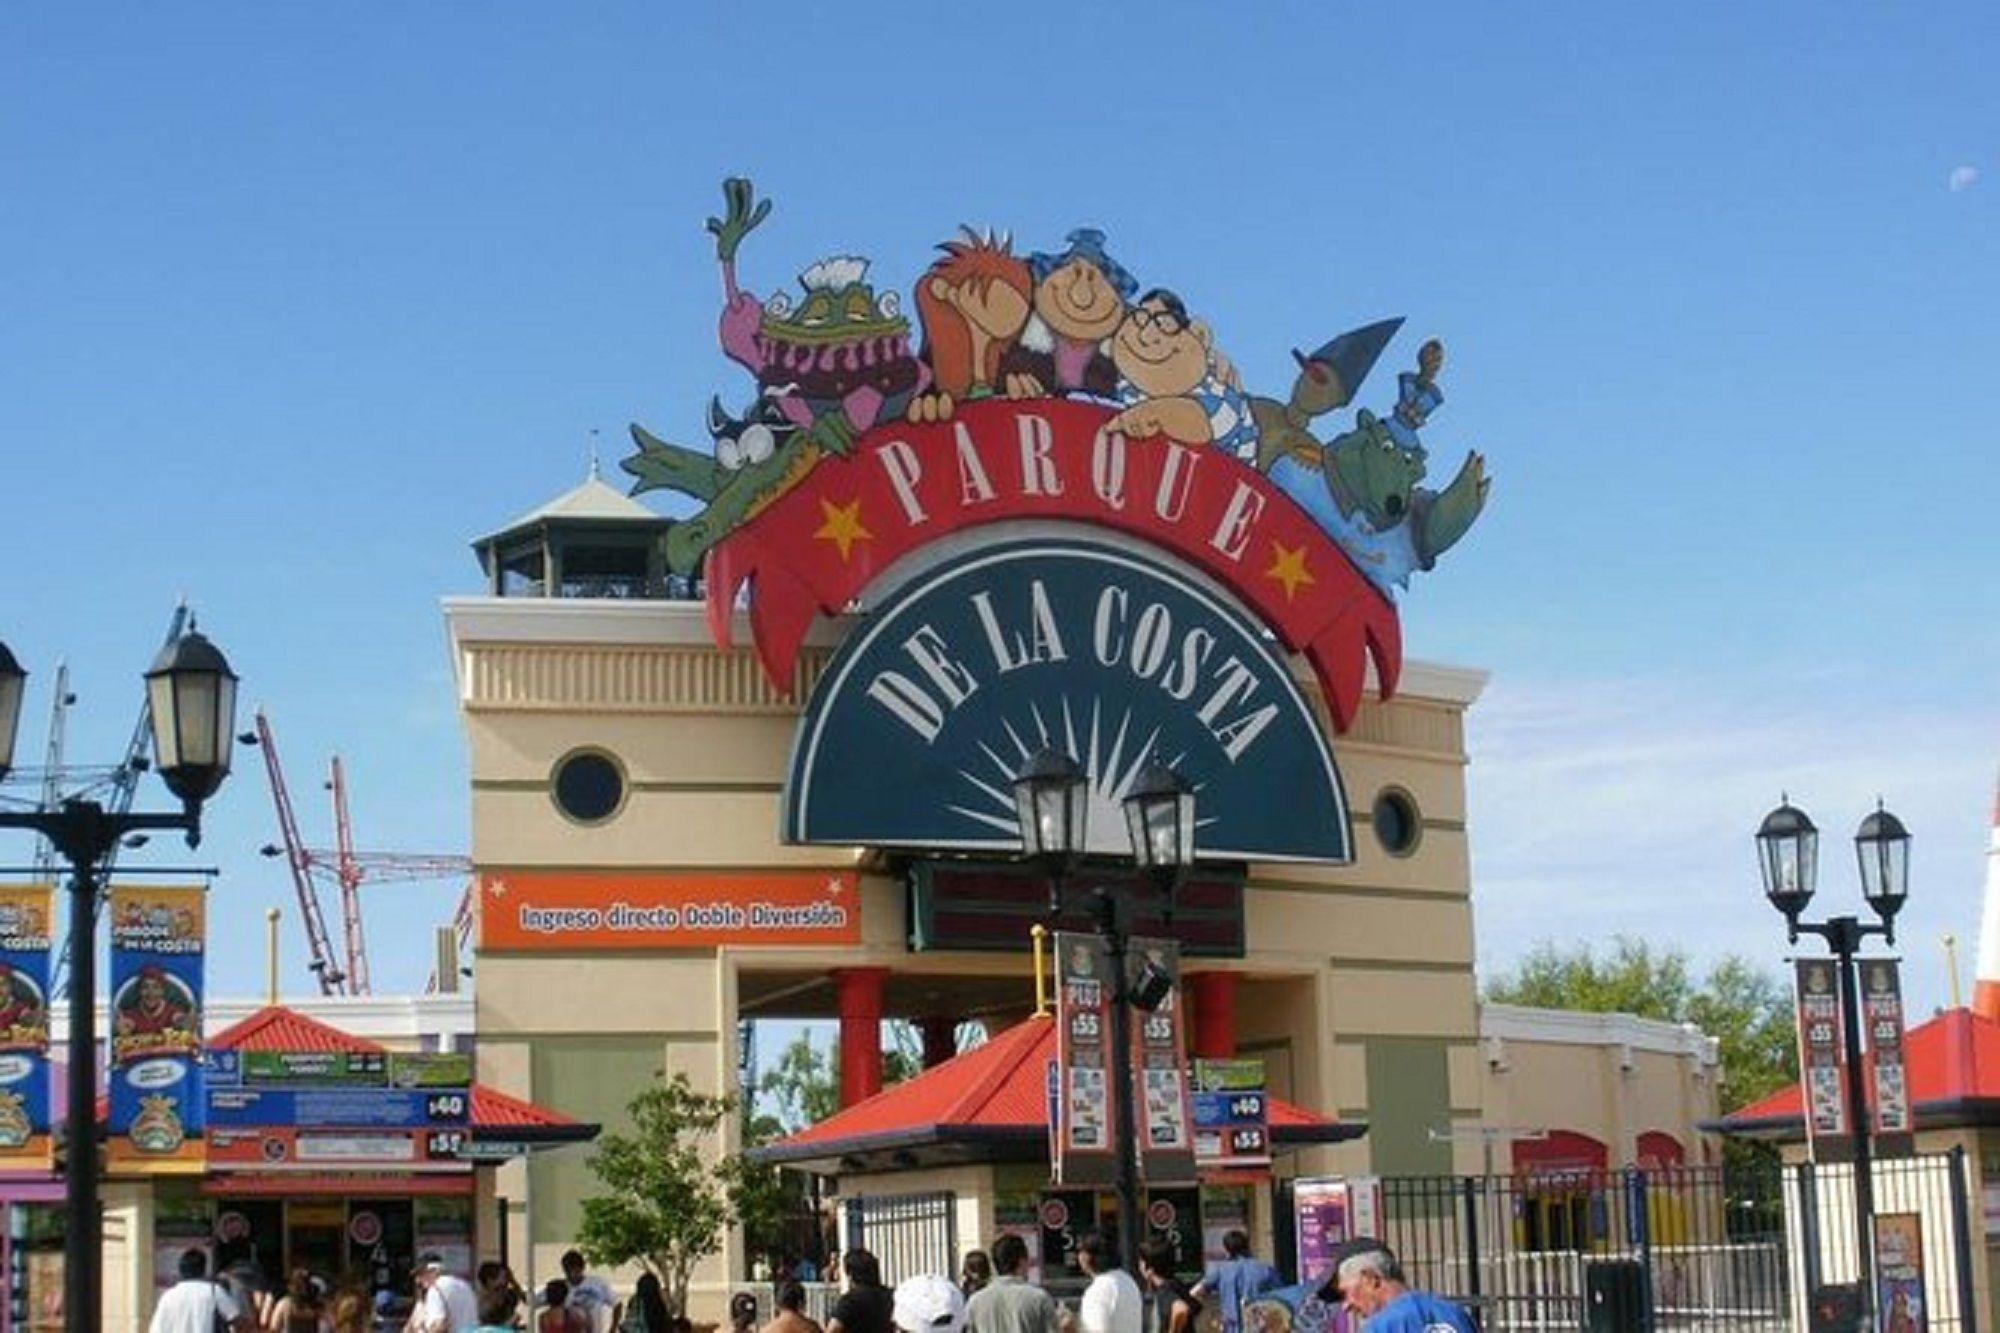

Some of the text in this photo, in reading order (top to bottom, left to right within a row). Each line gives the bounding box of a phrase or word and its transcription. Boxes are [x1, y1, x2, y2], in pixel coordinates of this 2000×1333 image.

[876, 414, 1266, 561] PARQUE
[866, 580, 1282, 764] DE LA COSTA
[520, 900, 847, 933] Ingreso directo Doble Diversión
